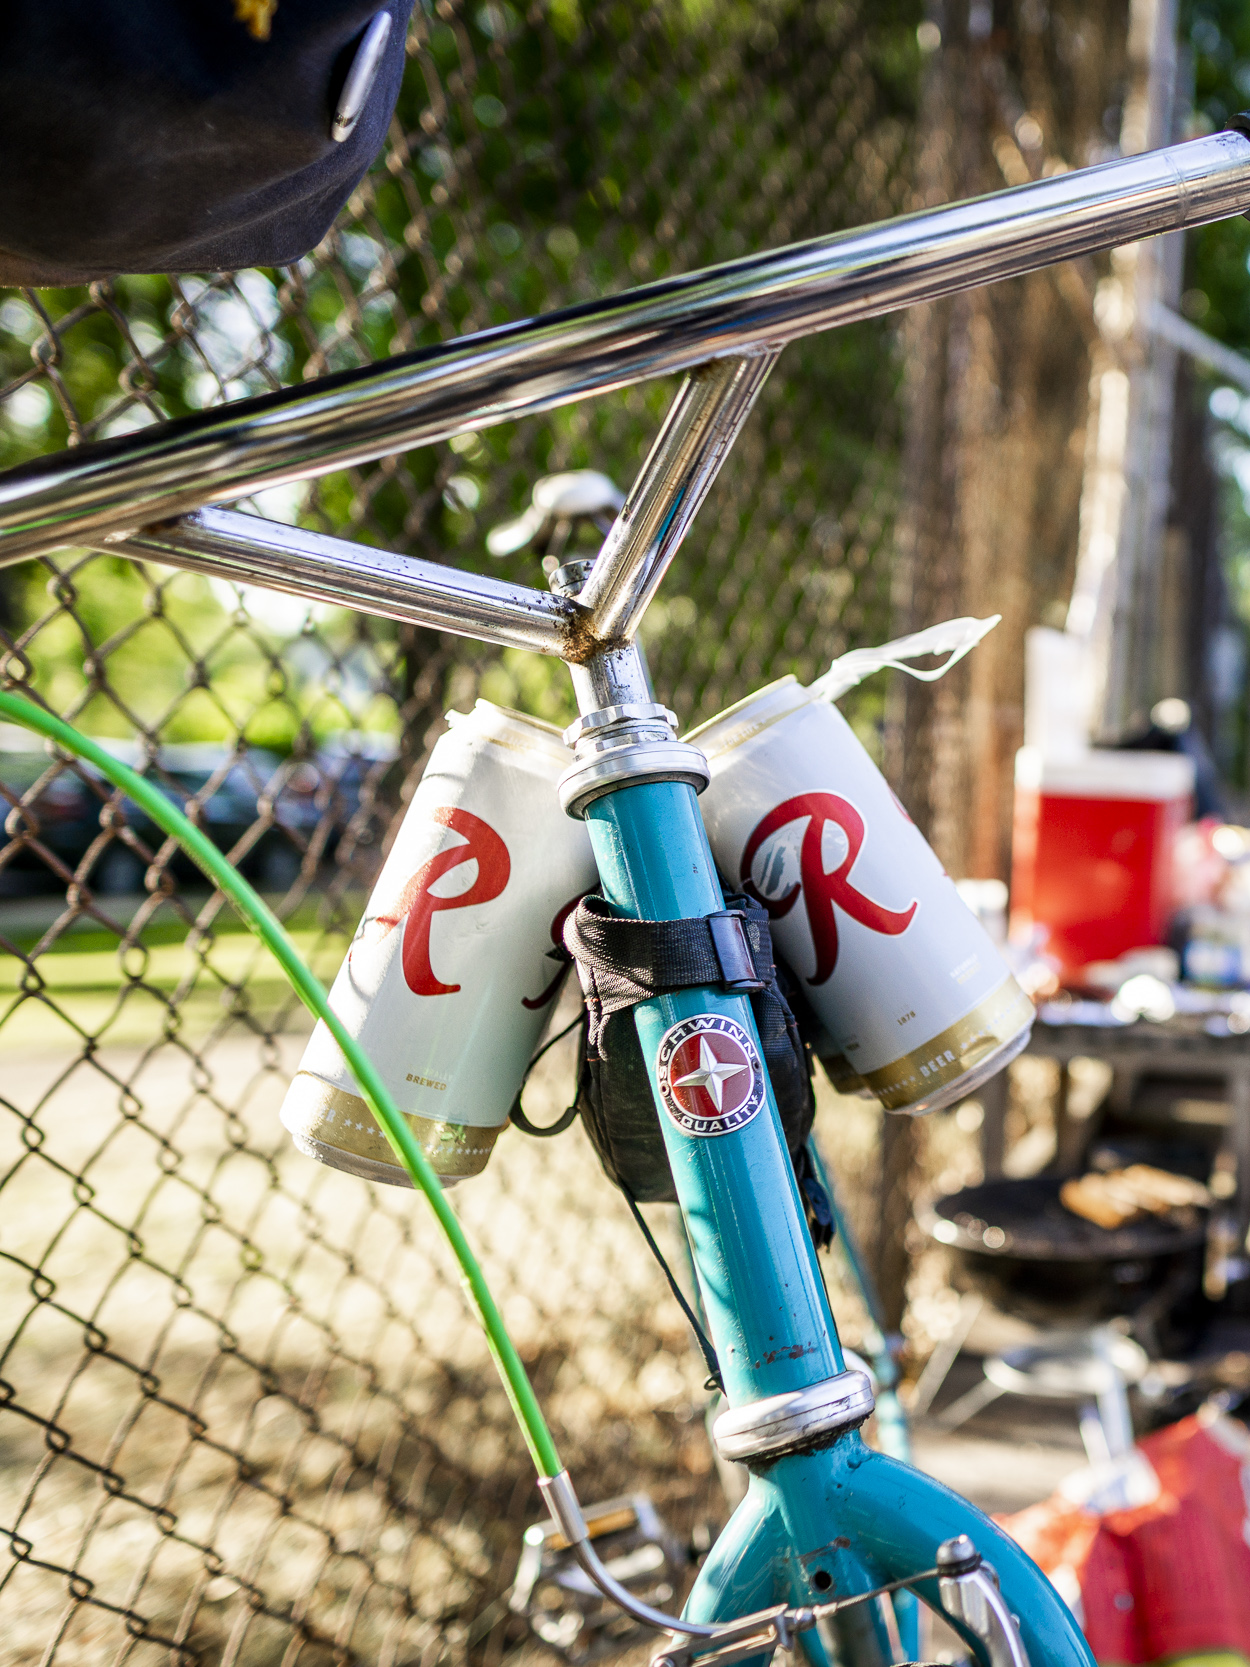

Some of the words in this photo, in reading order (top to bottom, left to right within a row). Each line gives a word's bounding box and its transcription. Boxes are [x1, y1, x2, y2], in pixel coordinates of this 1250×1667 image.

[739, 790, 919, 987] R
[659, 1017, 756, 1080] SCHWINN
[920, 1050, 956, 1078] BEER
[406, 1073, 447, 1091] BREWED
[681, 1094, 760, 1132] QUALITY
